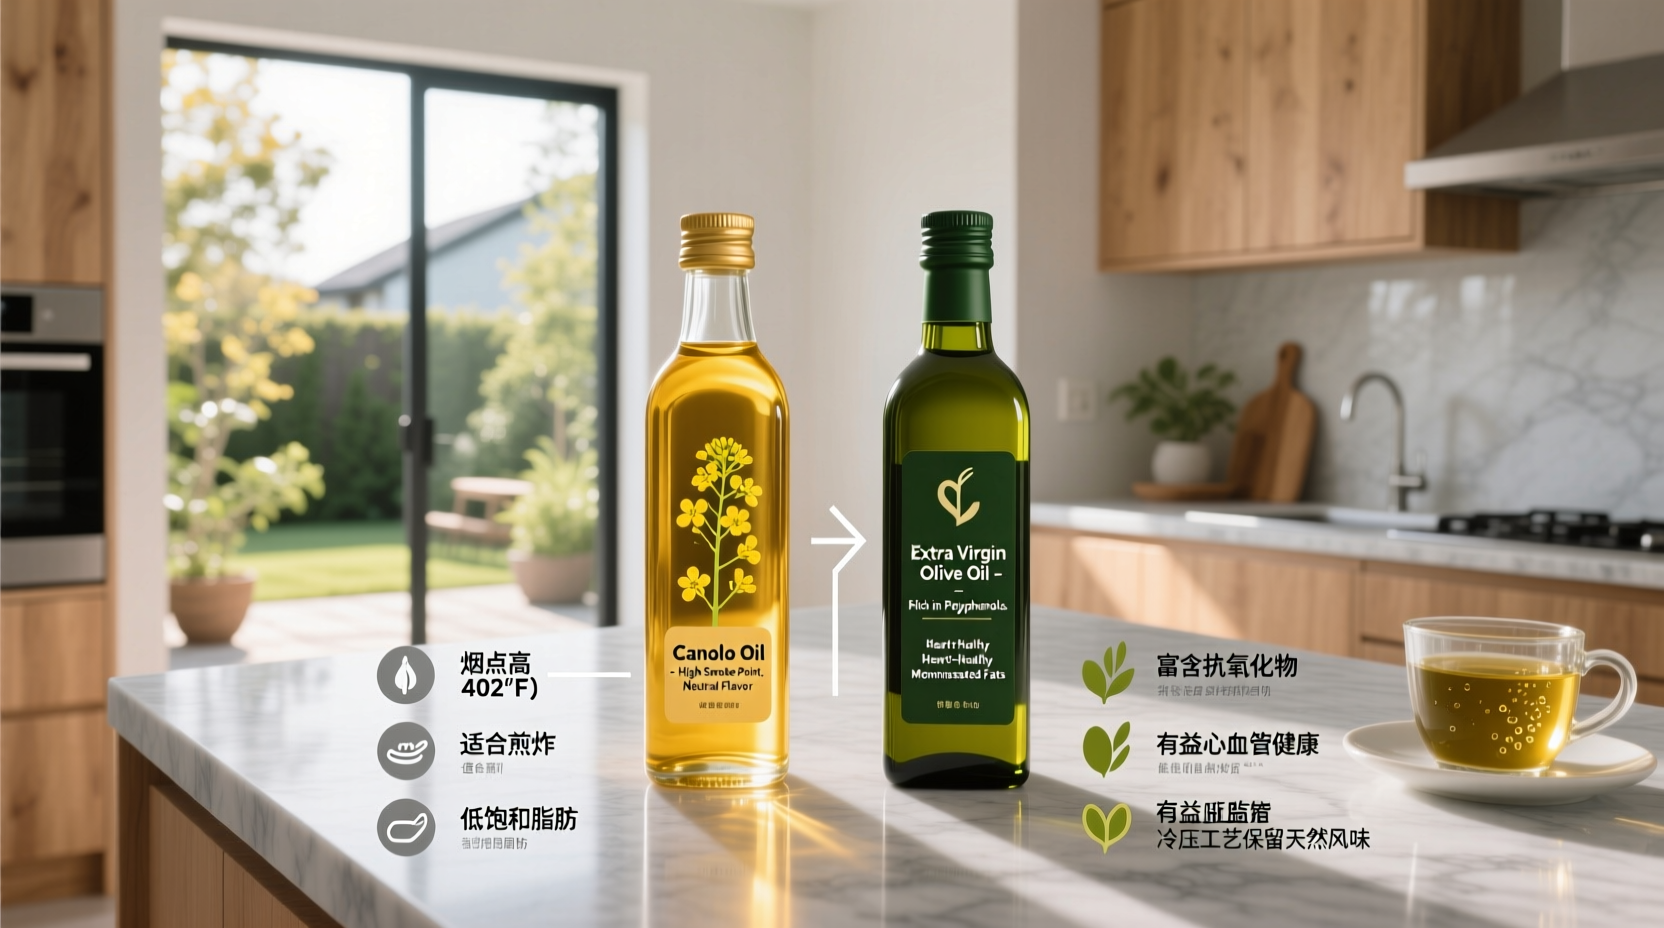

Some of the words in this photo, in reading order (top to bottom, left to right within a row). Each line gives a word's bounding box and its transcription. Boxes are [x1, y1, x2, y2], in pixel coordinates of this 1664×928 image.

[911, 544, 953, 561] Extra
[957, 545, 1006, 564] Virgin
[920, 564, 963, 581] Olive
[967, 565, 989, 581] Oil
[932, 599, 942, 611] in
[672, 643, 736, 661] Canolo
[740, 643, 765, 661] Oil
[678, 666, 702, 679] High
[721, 680, 754, 691] Flavor
